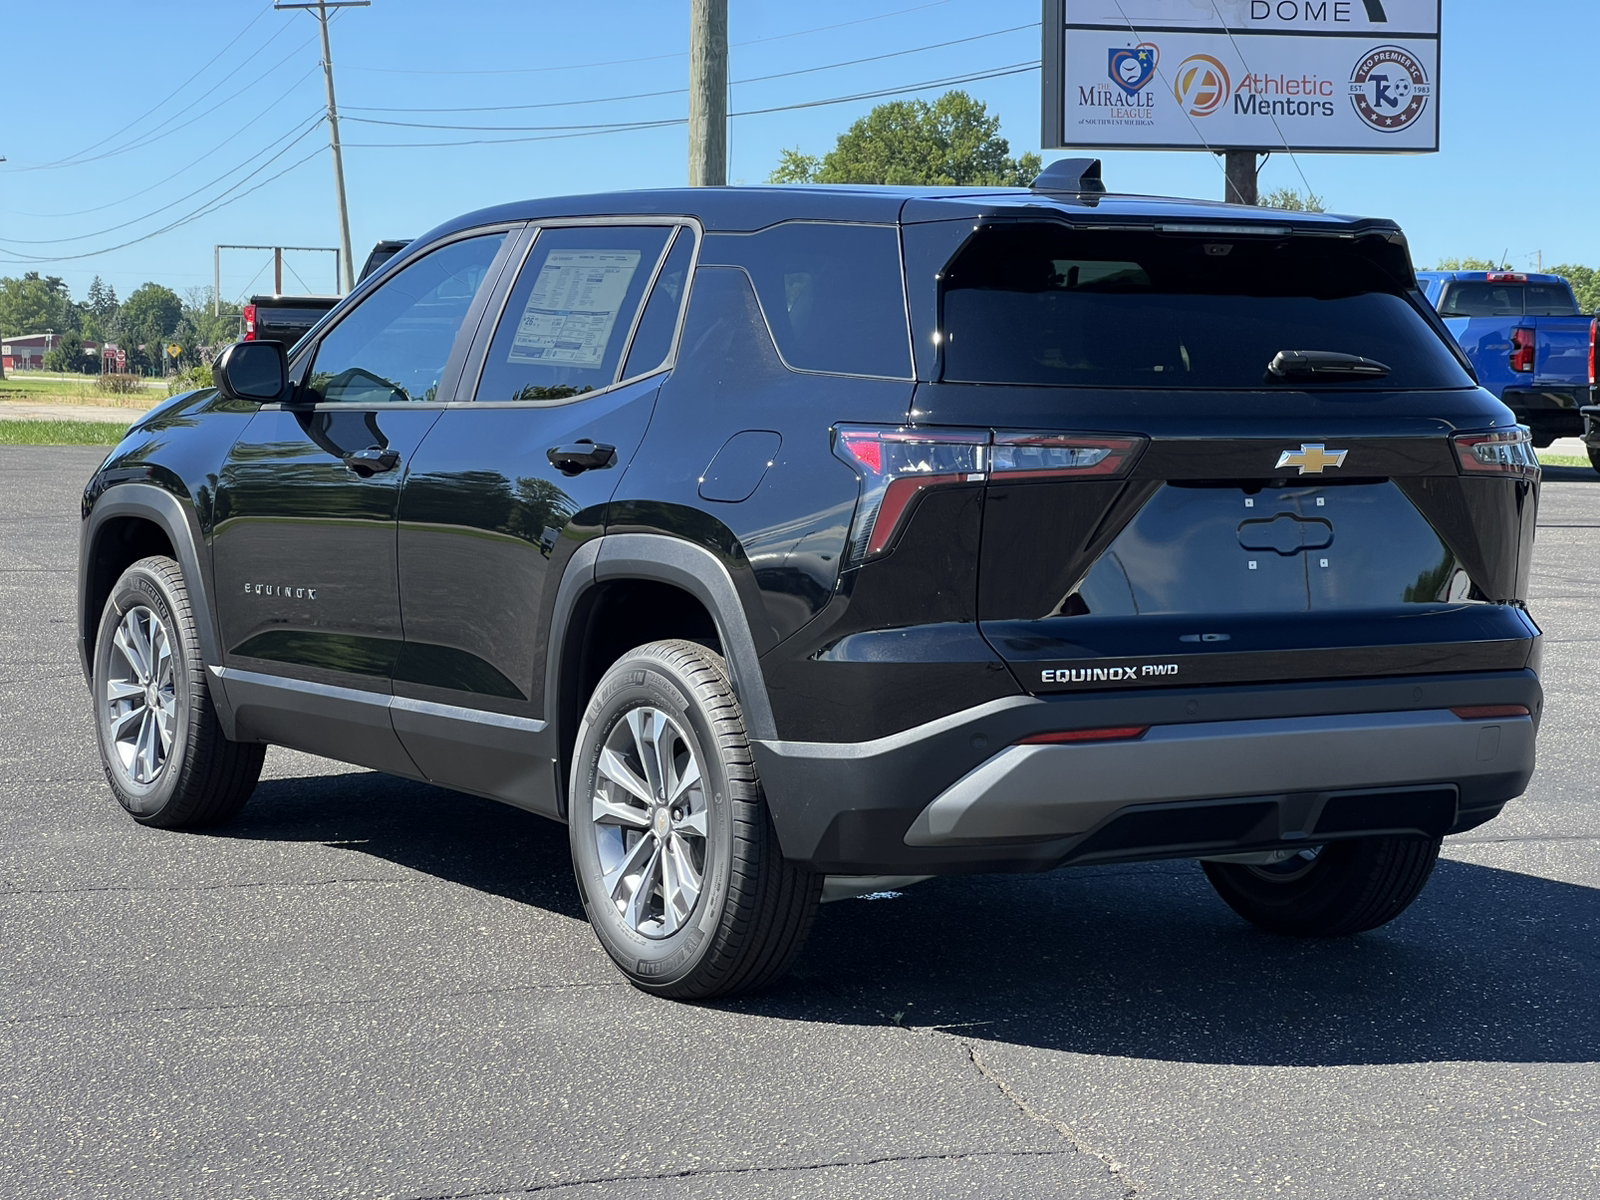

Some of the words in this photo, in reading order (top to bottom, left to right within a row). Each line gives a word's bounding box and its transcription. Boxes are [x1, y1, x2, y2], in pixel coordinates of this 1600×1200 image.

[1250, 1, 1351, 22] DOME
[1359, 59, 1374, 76] TKO
[1374, 52, 1412, 68] PREMIER
[1409, 65, 1420, 78] SC
[1234, 73, 1334, 96] Athletic
[1413, 86, 1430, 94] 1983
[1110, 108, 1152, 119] LEAGUE
[1234, 93, 1335, 117] Mentors
[244, 583, 317, 600] EQUINOX
[1041, 667, 1138, 683] EQUINOX
[1141, 664, 1179, 676] AWD
